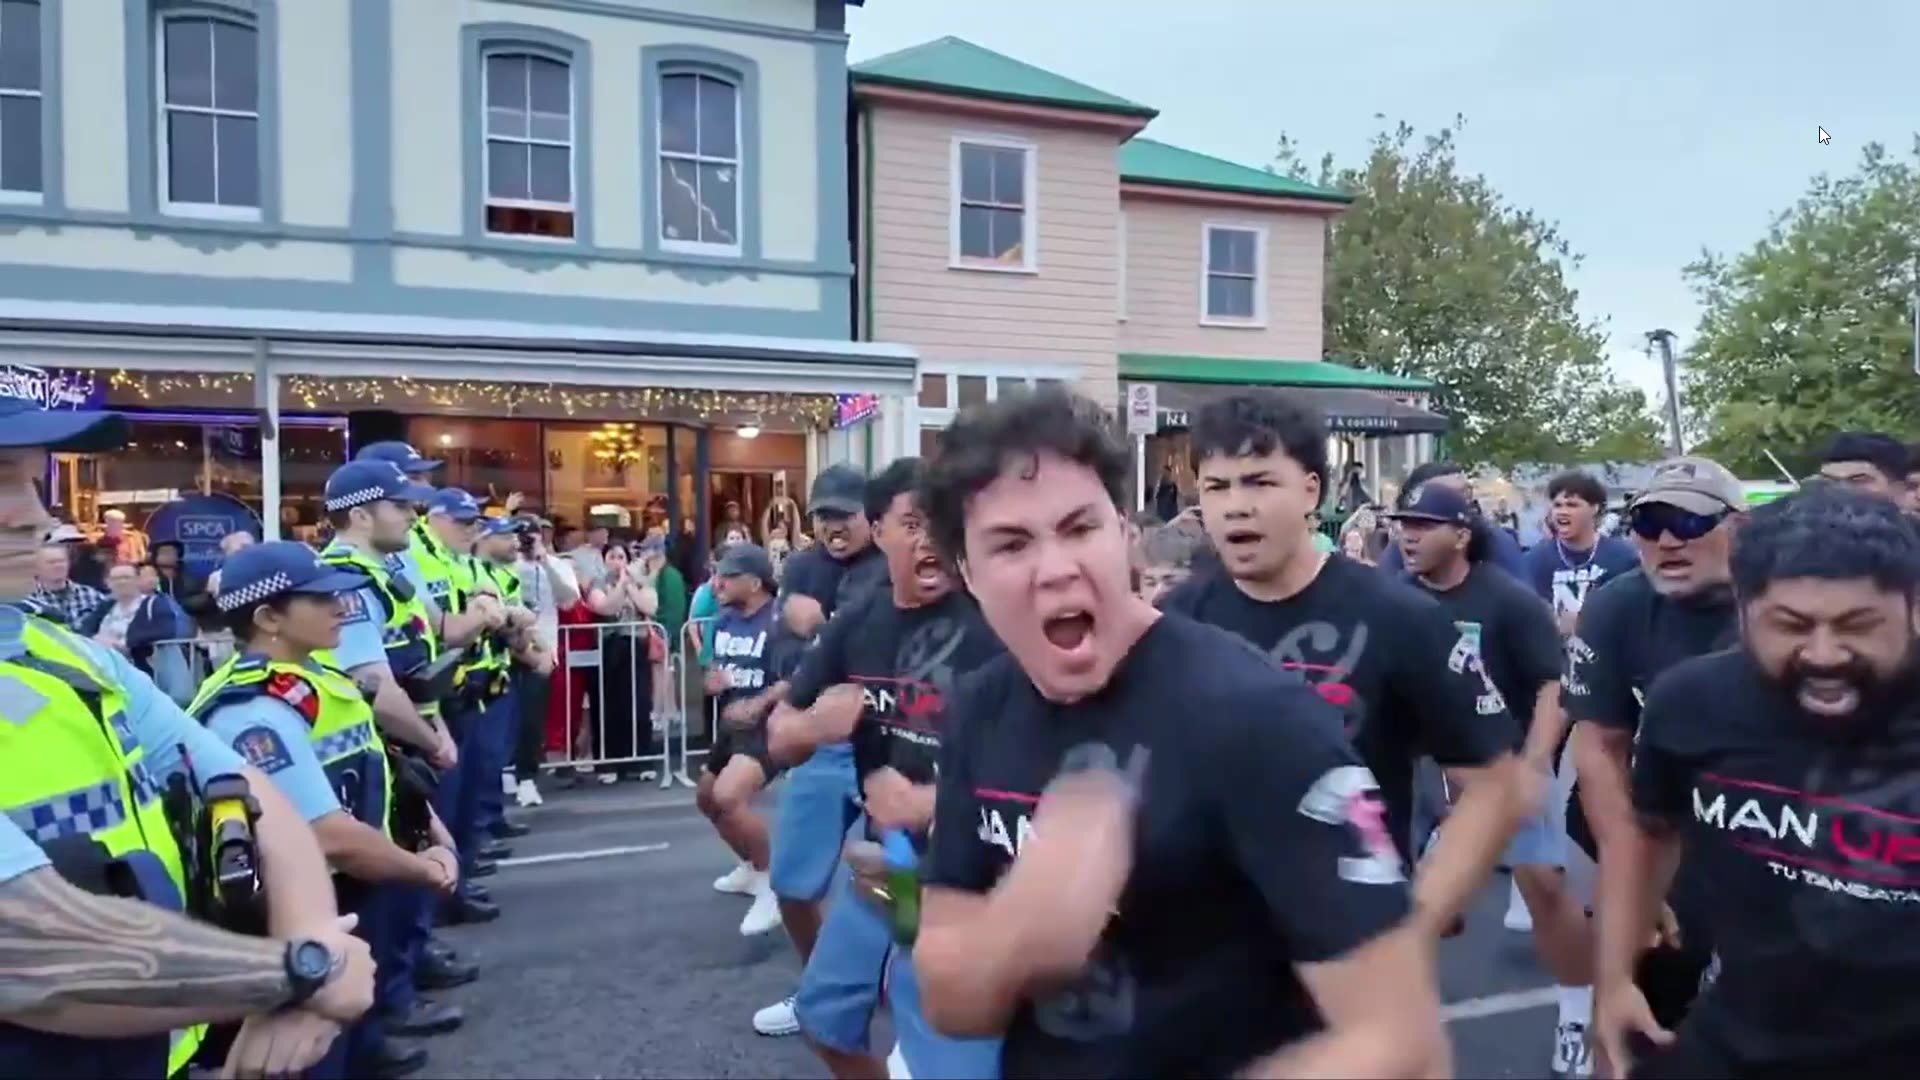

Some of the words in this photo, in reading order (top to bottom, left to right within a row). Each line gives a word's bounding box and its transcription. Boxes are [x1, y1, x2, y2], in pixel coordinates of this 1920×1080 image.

[183, 522, 225, 537] SPCA
[1692, 787, 1818, 848] MAN
[1767, 861, 1797, 881] TU
